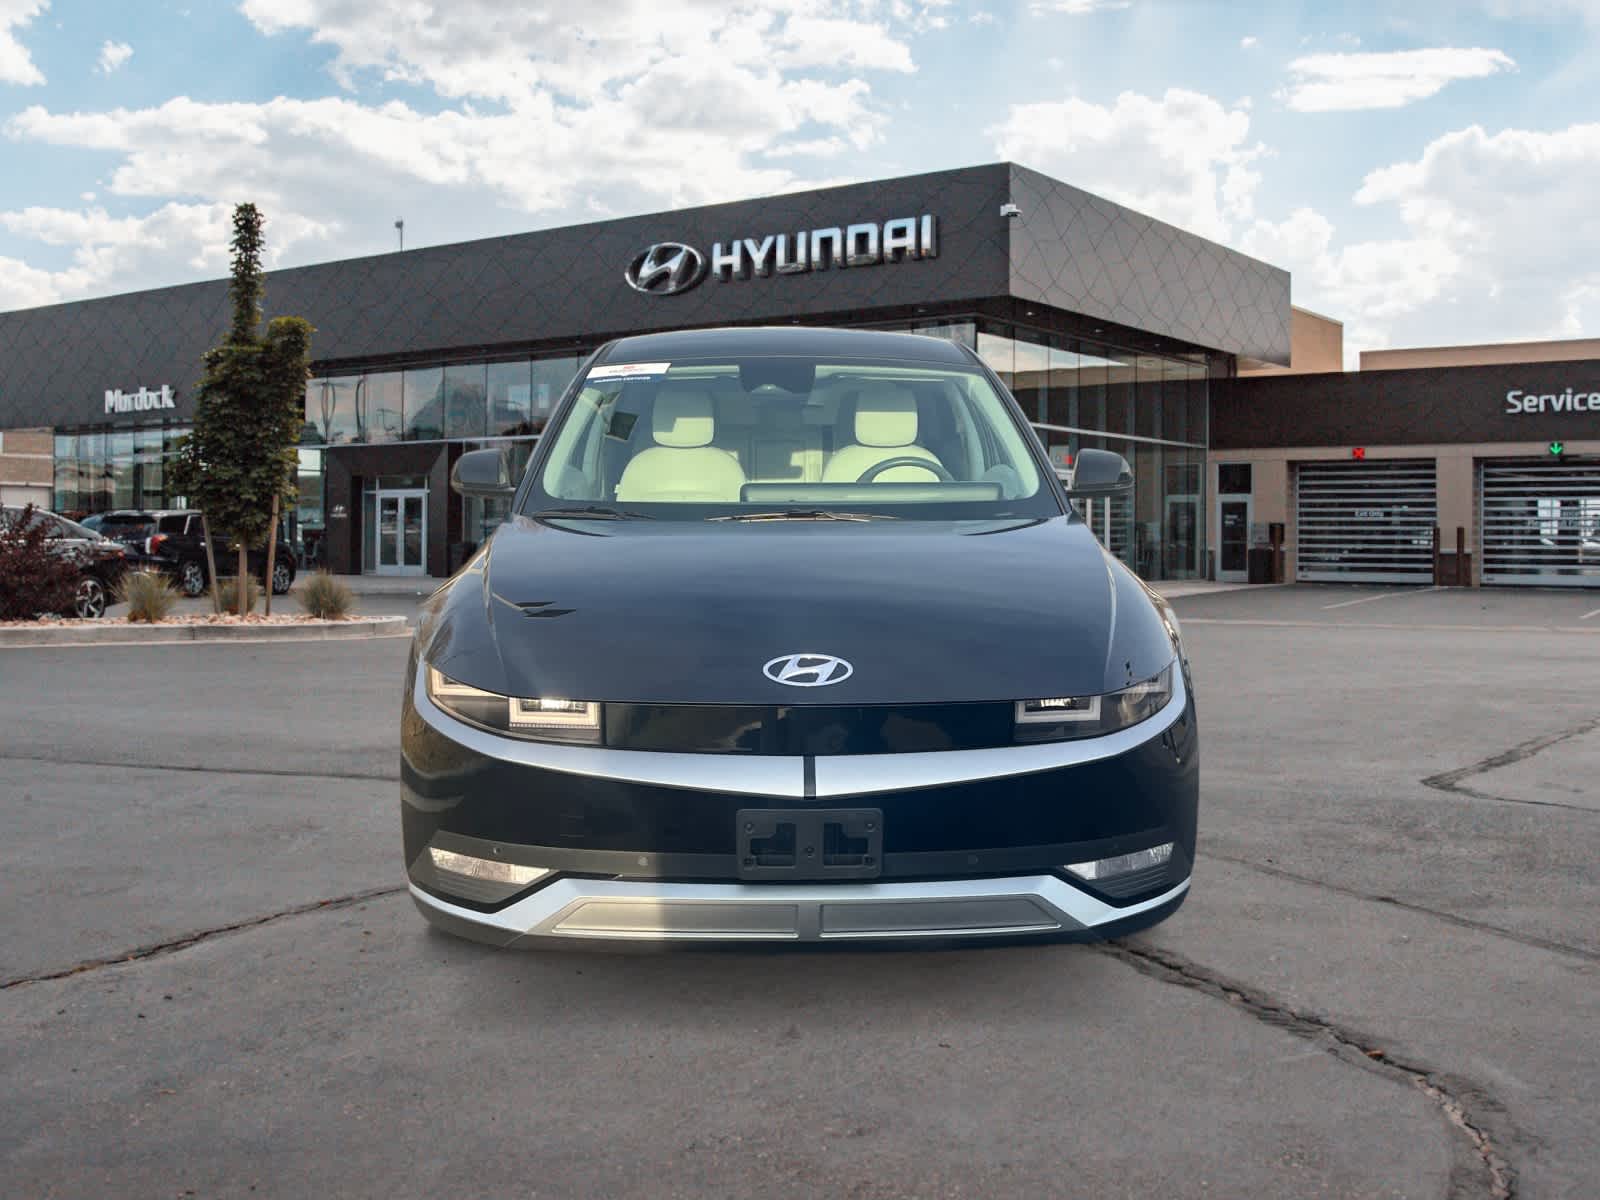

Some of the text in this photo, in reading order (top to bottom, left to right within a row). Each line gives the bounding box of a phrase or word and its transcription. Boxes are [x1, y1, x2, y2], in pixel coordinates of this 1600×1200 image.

[711, 214, 937, 282] HYUNDAI
[104, 384, 176, 414] Murdock
[1505, 387, 1600, 414] Service
